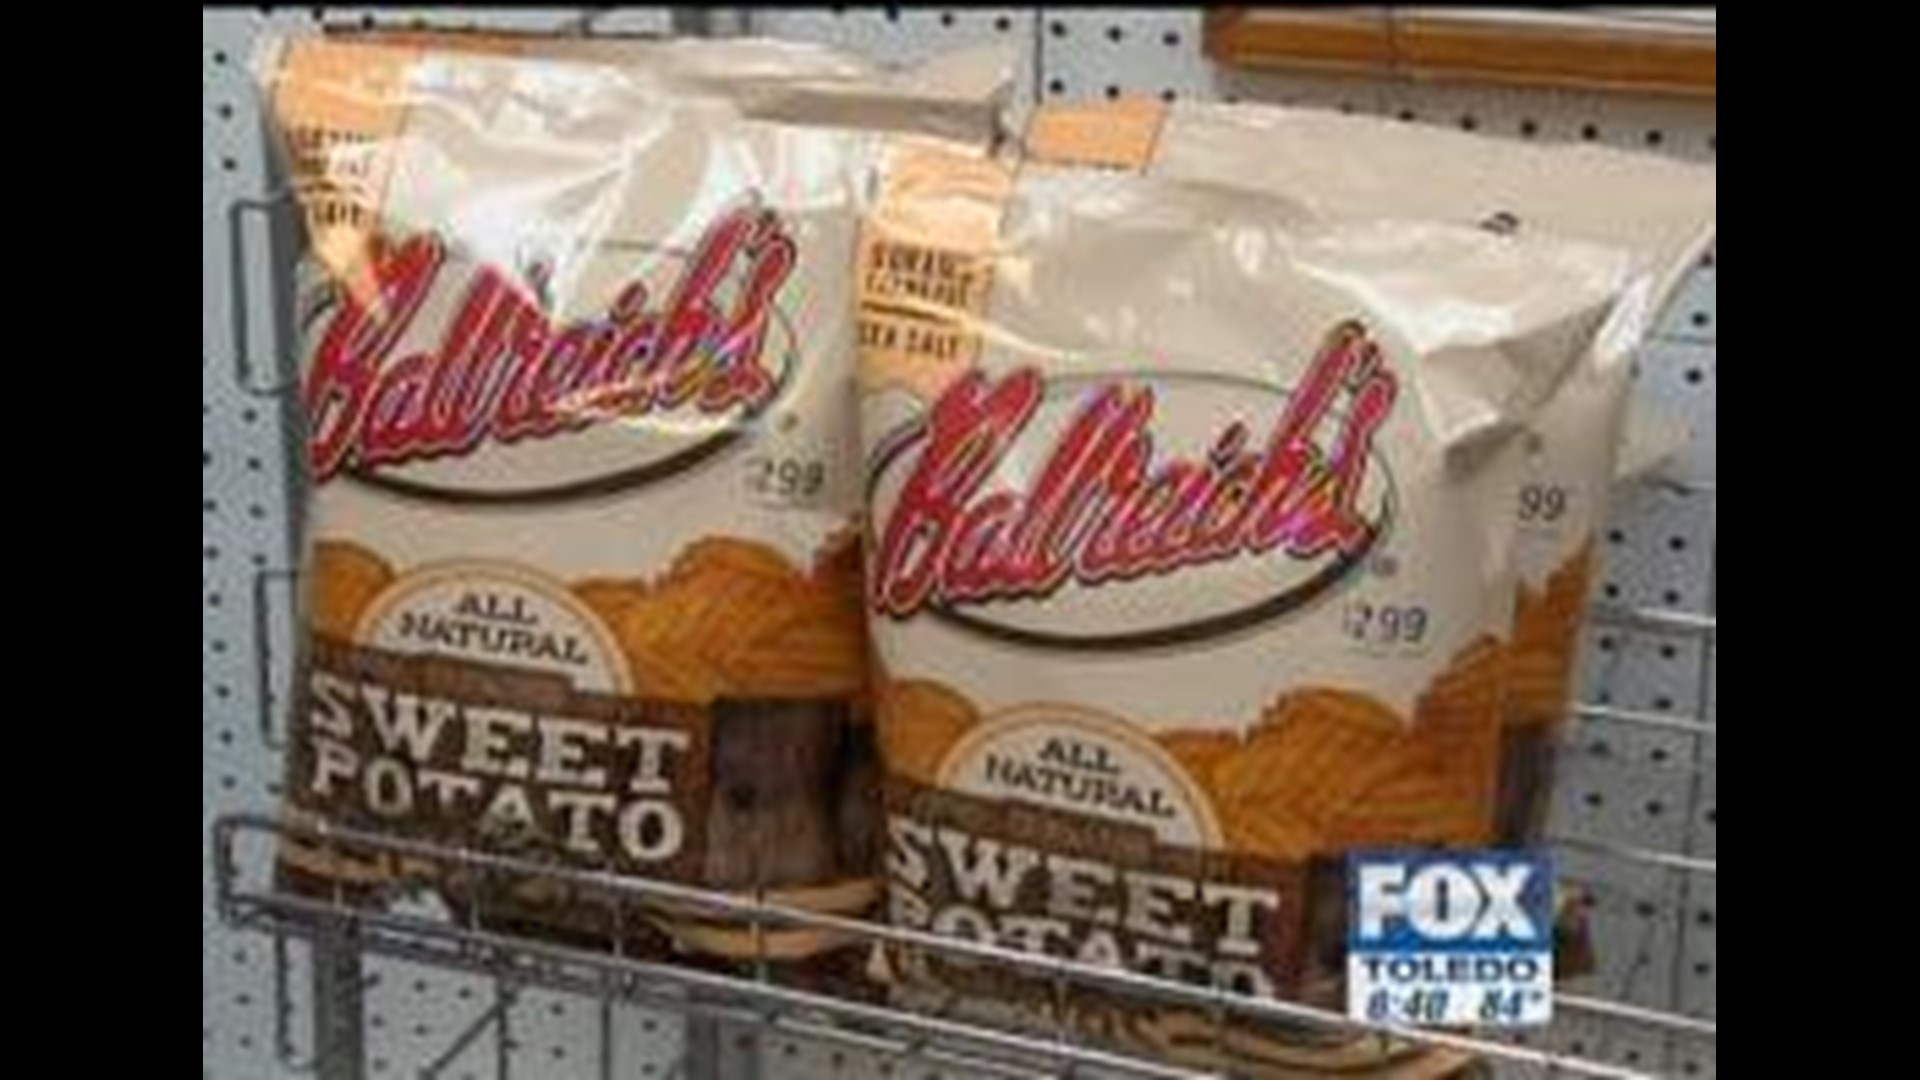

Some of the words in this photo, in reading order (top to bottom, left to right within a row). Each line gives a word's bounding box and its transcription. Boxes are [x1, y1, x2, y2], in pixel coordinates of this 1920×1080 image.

[399, 610, 590, 667] NATURAL
[453, 594, 540, 626] ALL
[309, 672, 690, 793] SWEET
[1037, 736, 1123, 775] ALL
[311, 734, 685, 861] POTATO
[983, 752, 1178, 820] NATURAL
[886, 814, 1281, 956] SWEET
